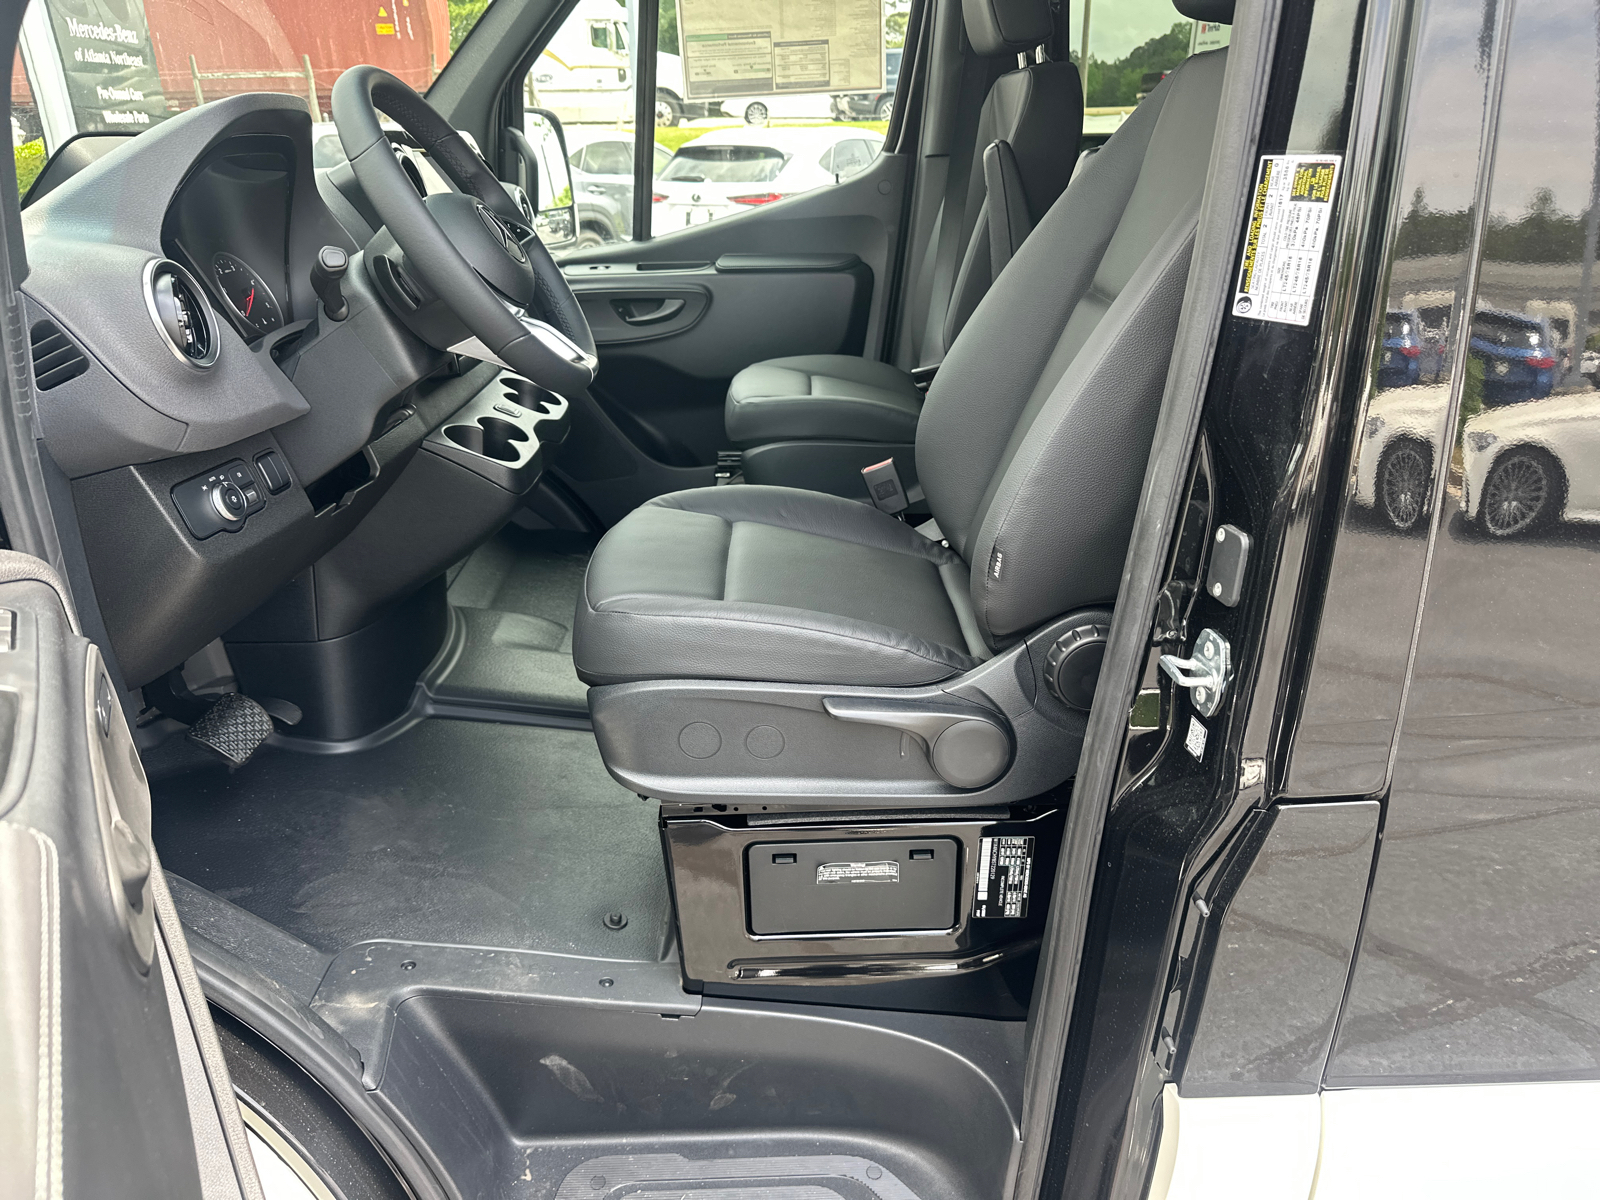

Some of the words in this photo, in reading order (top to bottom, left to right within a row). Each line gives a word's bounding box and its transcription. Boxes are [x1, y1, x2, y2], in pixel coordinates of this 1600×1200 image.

[66, 17, 139, 44] Mercedes-Benz
[74, 47, 83, 61] of
[84, 48, 111, 64] Atlanta
[110, 50, 144, 67] Northeast
[993, 552, 1003, 579] AIRBAG
